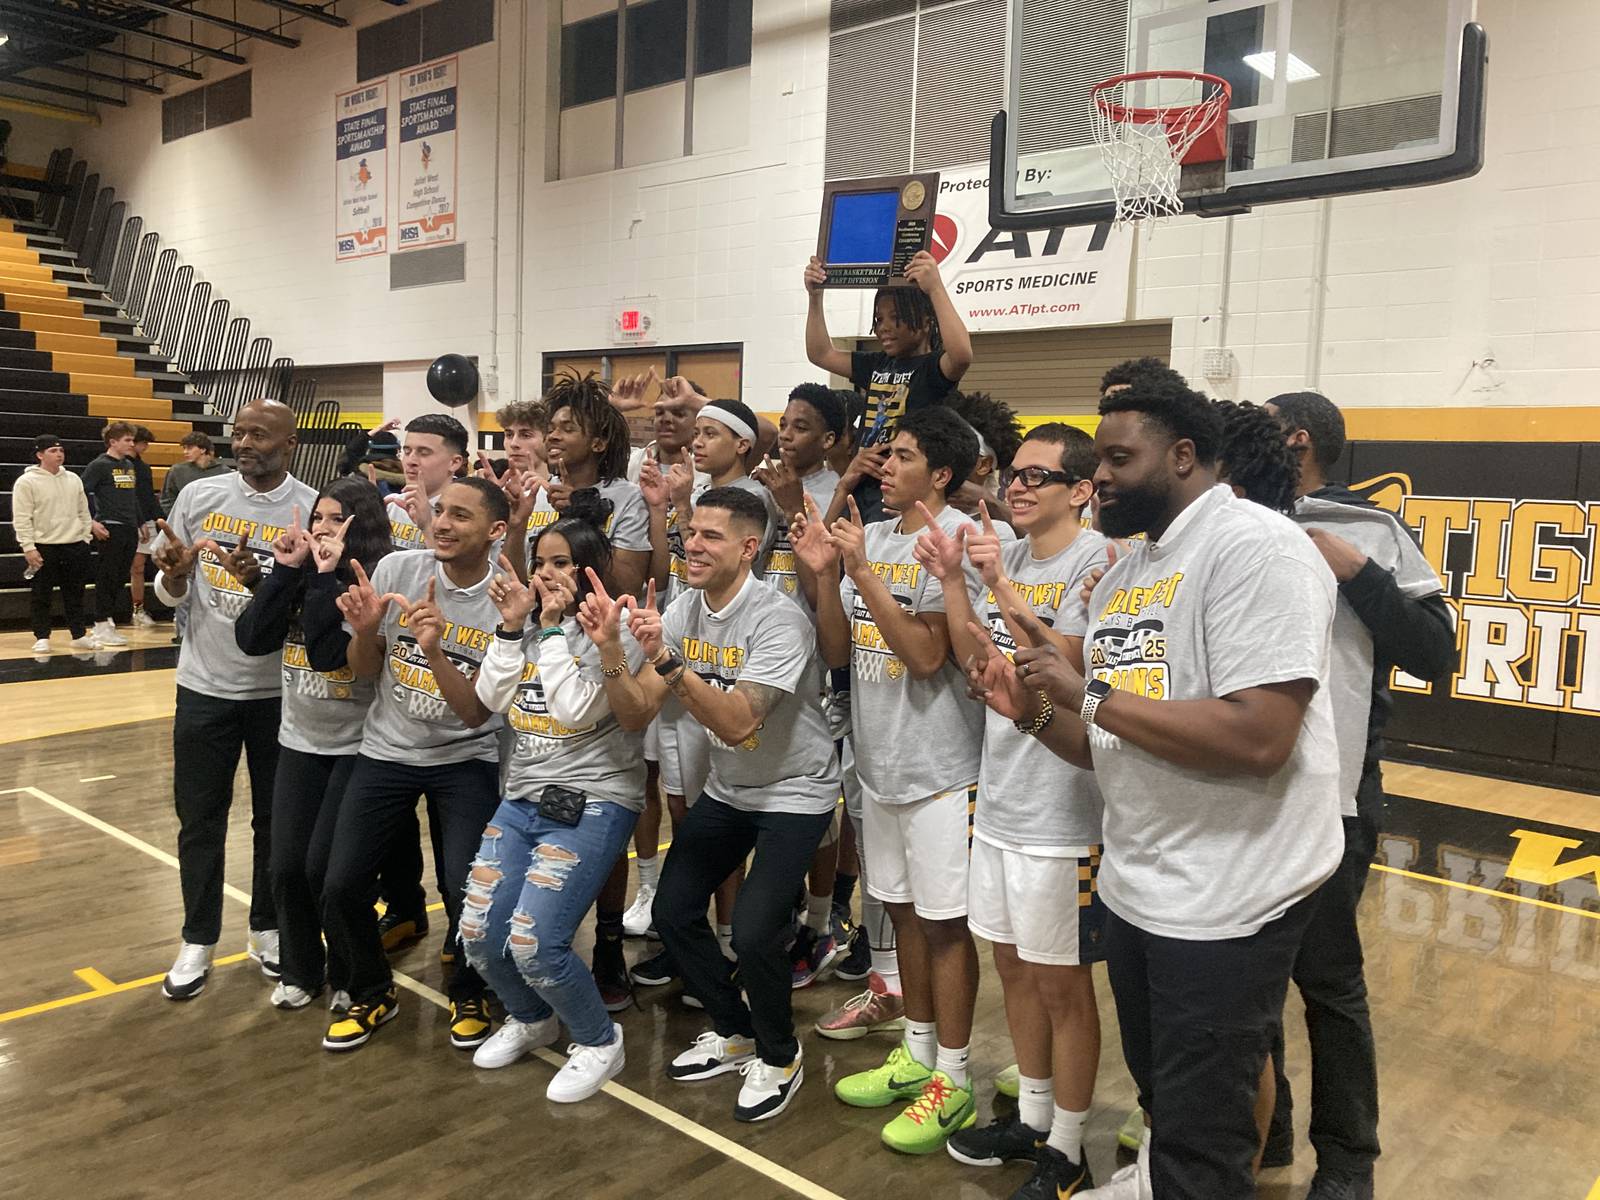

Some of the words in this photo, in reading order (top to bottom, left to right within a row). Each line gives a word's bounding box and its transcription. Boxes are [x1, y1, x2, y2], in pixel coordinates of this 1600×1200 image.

[409, 100, 426, 114] STATE
[427, 94, 448, 109] FINAL
[343, 120, 360, 134] STATE
[361, 114, 378, 129] FINAL
[400, 104, 455, 128] SPORTSMANSHIP
[337, 124, 386, 146] SPORTSMANSHIP
[416, 120, 439, 135] AWARD
[349, 139, 372, 153] AWARD
[1024, 168, 1052, 184] By:
[413, 188, 423, 199] High
[423, 185, 440, 195] School
[352, 205, 370, 216] Softball
[843, 268, 886, 276] BASKETBALL
[956, 278, 1014, 295] SPORTS
[1018, 271, 1098, 290] MEDICINE
[202, 512, 258, 539] JOLIET
[200, 549, 213, 560] 20
[891, 562, 921, 589] WEST
[999, 636, 1013, 646] EAST
[1144, 639, 1166, 659] 25
[392, 644, 407, 658] 20
[1091, 648, 1105, 665] 20
